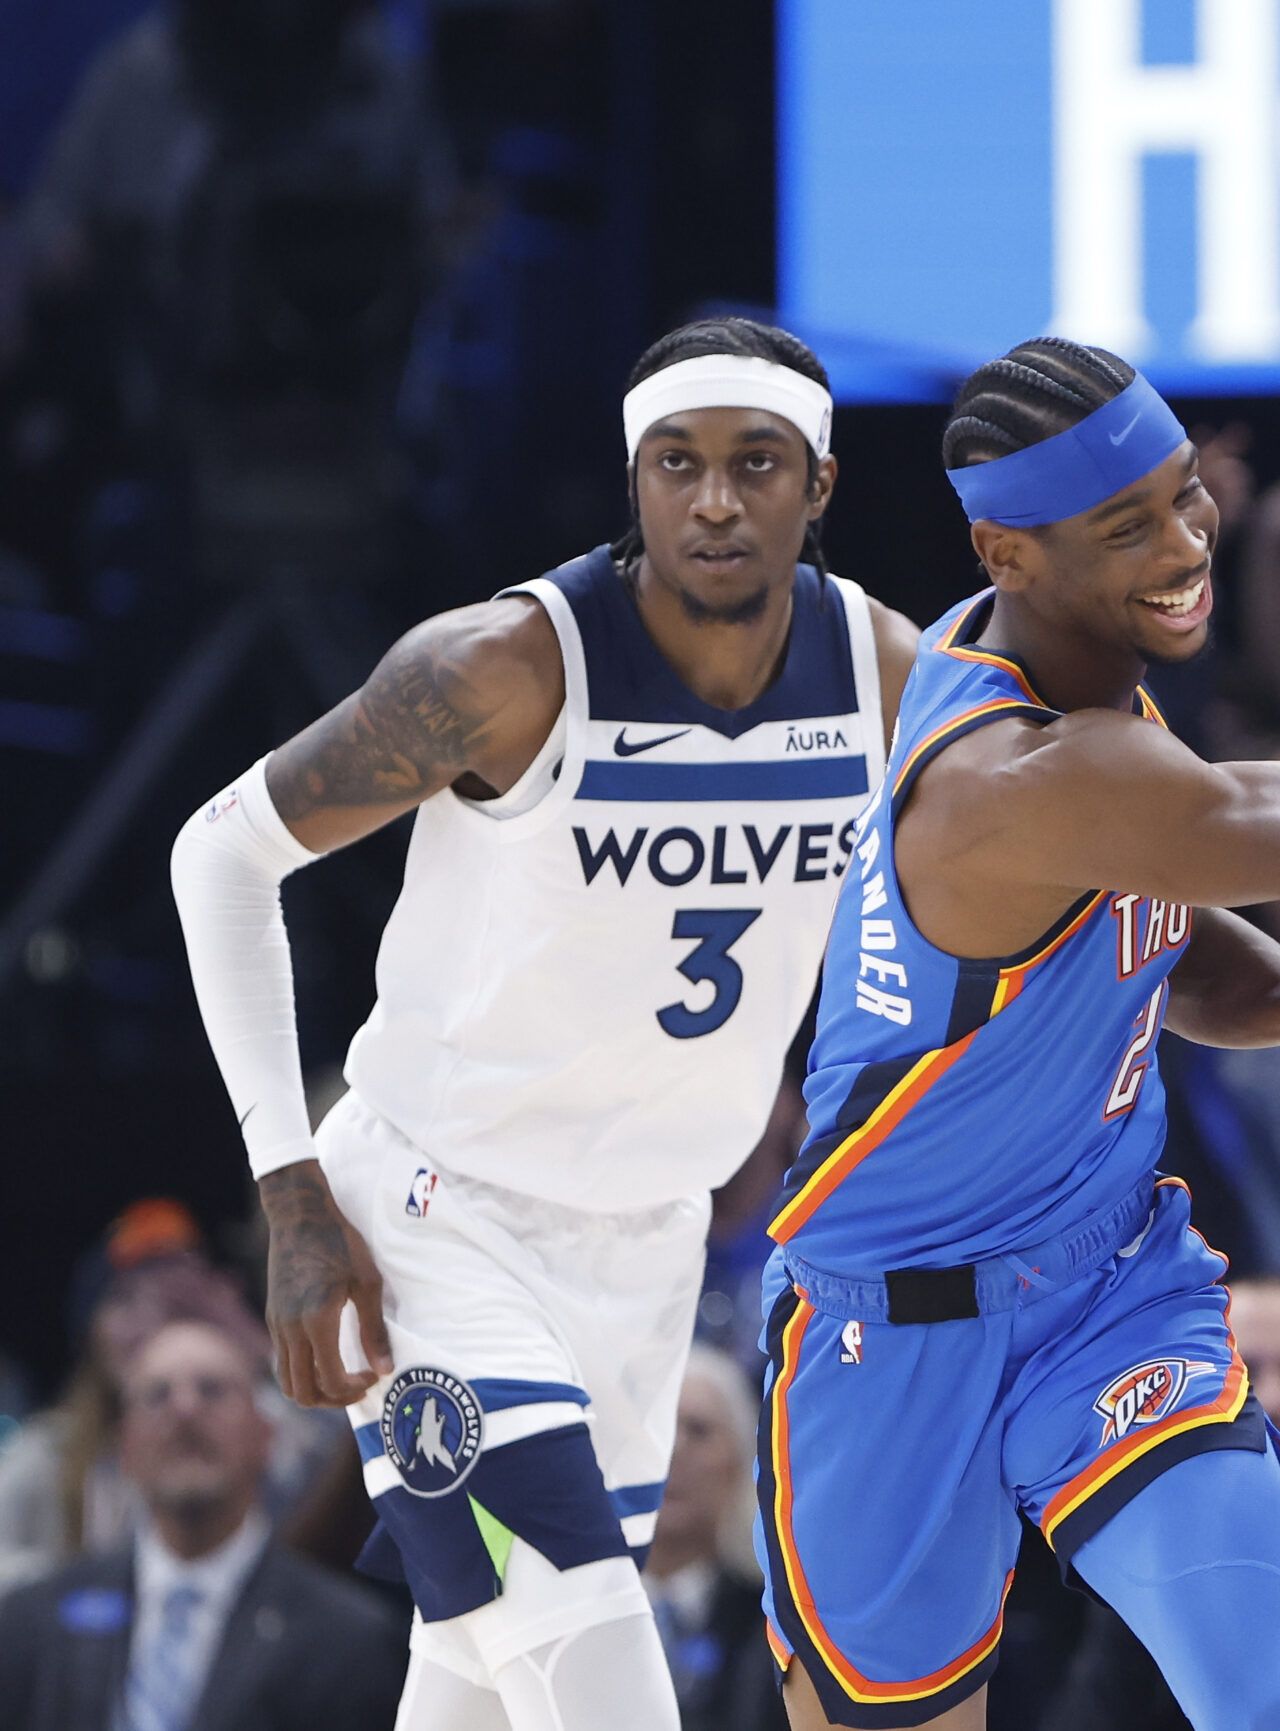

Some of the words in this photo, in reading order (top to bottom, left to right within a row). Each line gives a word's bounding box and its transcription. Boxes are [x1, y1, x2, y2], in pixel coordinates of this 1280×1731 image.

[572, 818, 858, 887] WOLVES
[656, 908, 763, 1039] 3
[410, 1370, 479, 1459] TIMBERWOLVES
[1112, 1366, 1167, 1438] OKC
